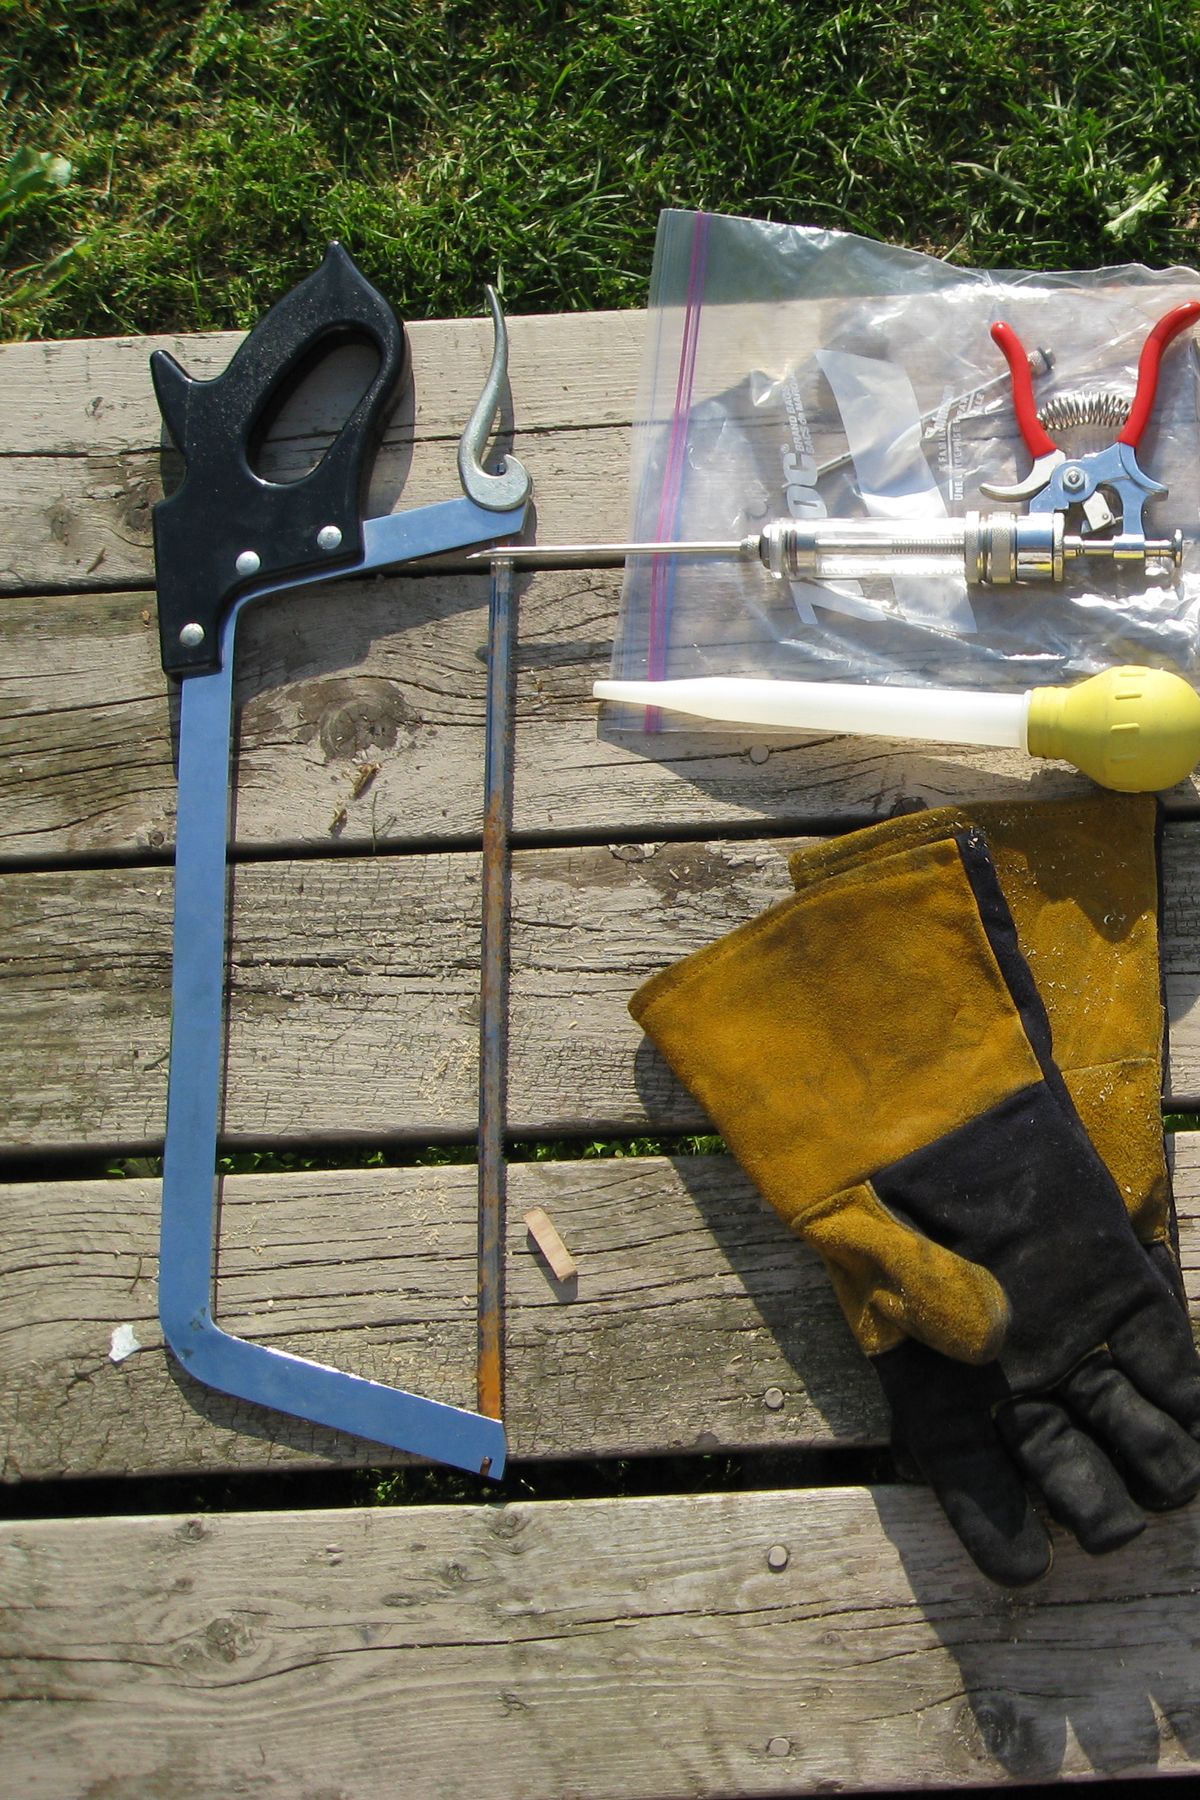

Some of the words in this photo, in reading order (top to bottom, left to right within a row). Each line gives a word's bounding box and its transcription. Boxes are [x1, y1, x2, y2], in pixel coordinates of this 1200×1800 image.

[782, 384, 796, 414] BAGS
[789, 416, 805, 452] BRAND
[800, 426, 815, 454] SACS
[953, 481, 963, 501] UNE
